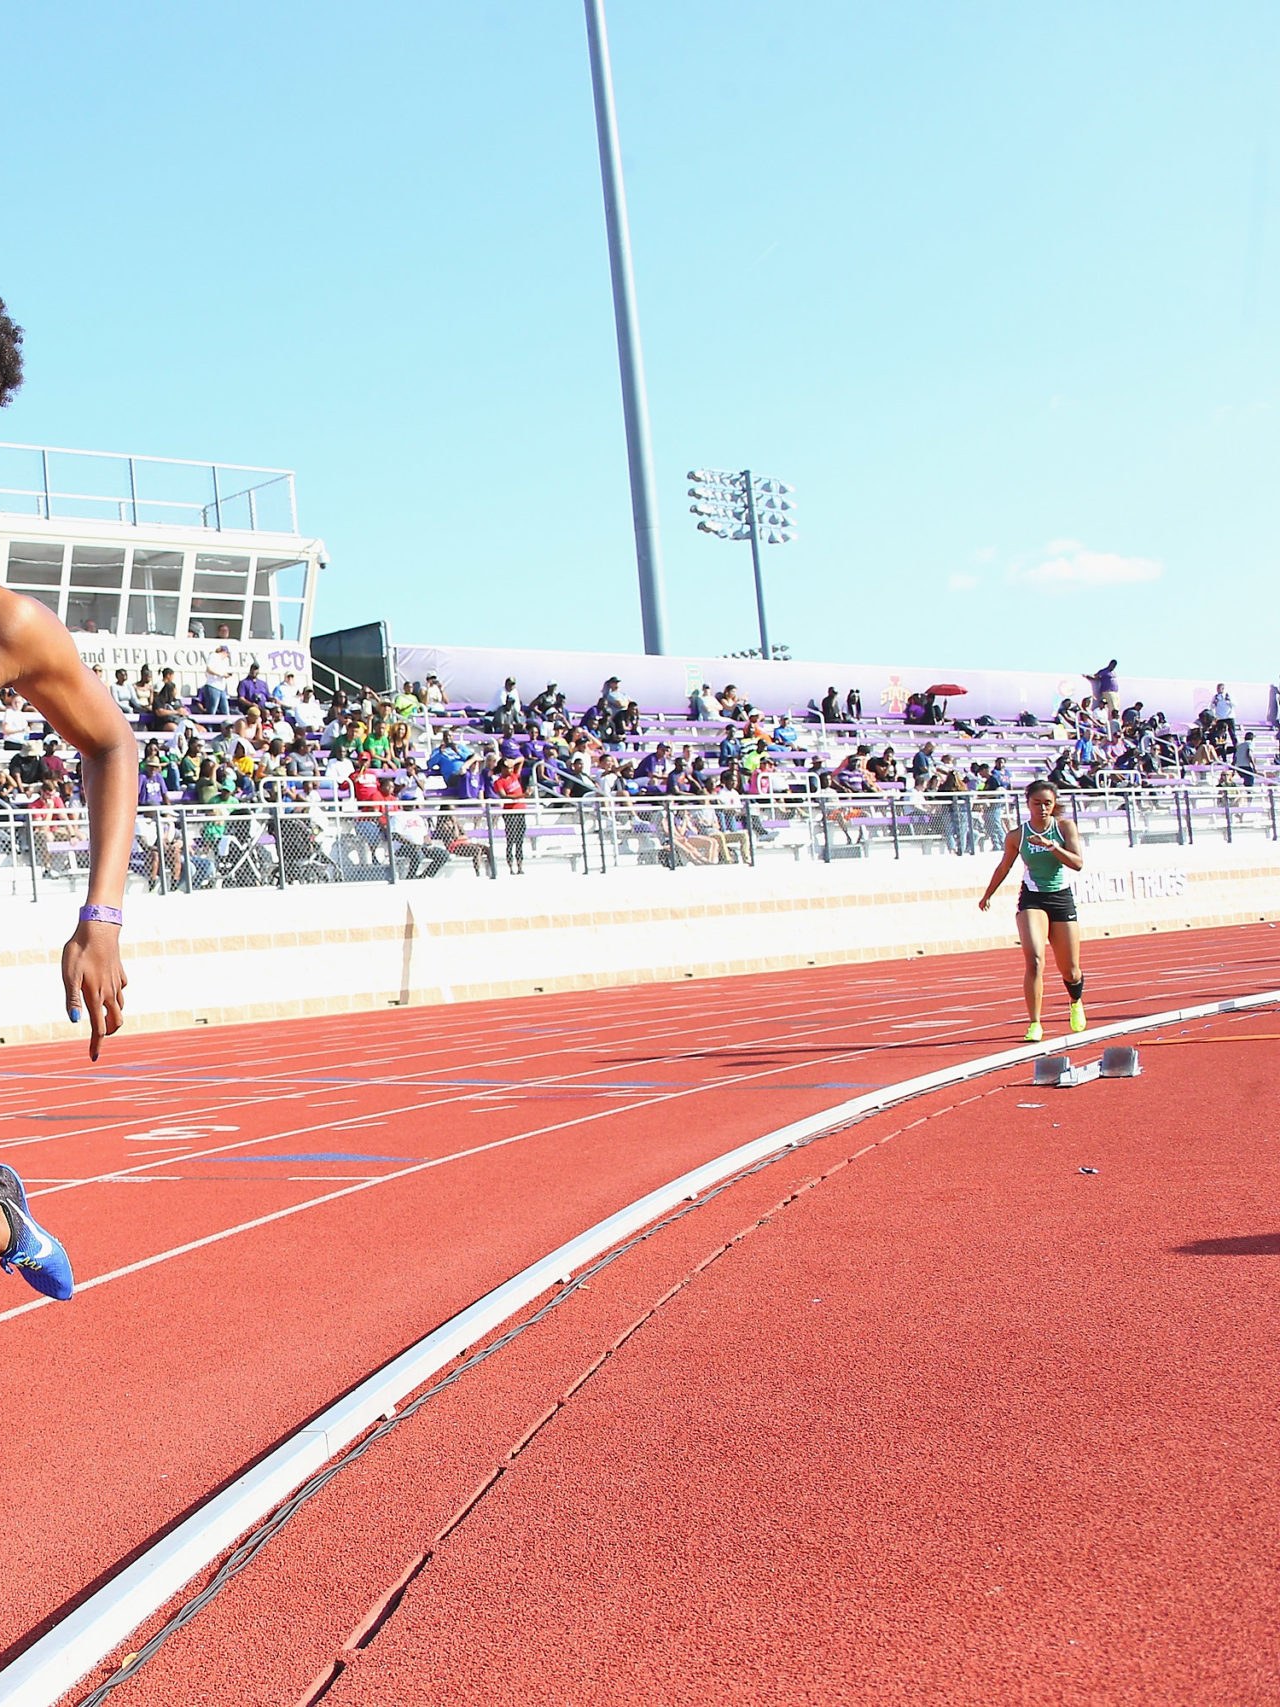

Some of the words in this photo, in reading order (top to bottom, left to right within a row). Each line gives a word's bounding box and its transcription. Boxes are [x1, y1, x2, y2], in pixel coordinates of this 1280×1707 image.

[80, 647, 105, 663] and
[113, 648, 167, 664] FIELD
[174, 649, 260, 669] COLEX
[268, 650, 305, 671] TCU
